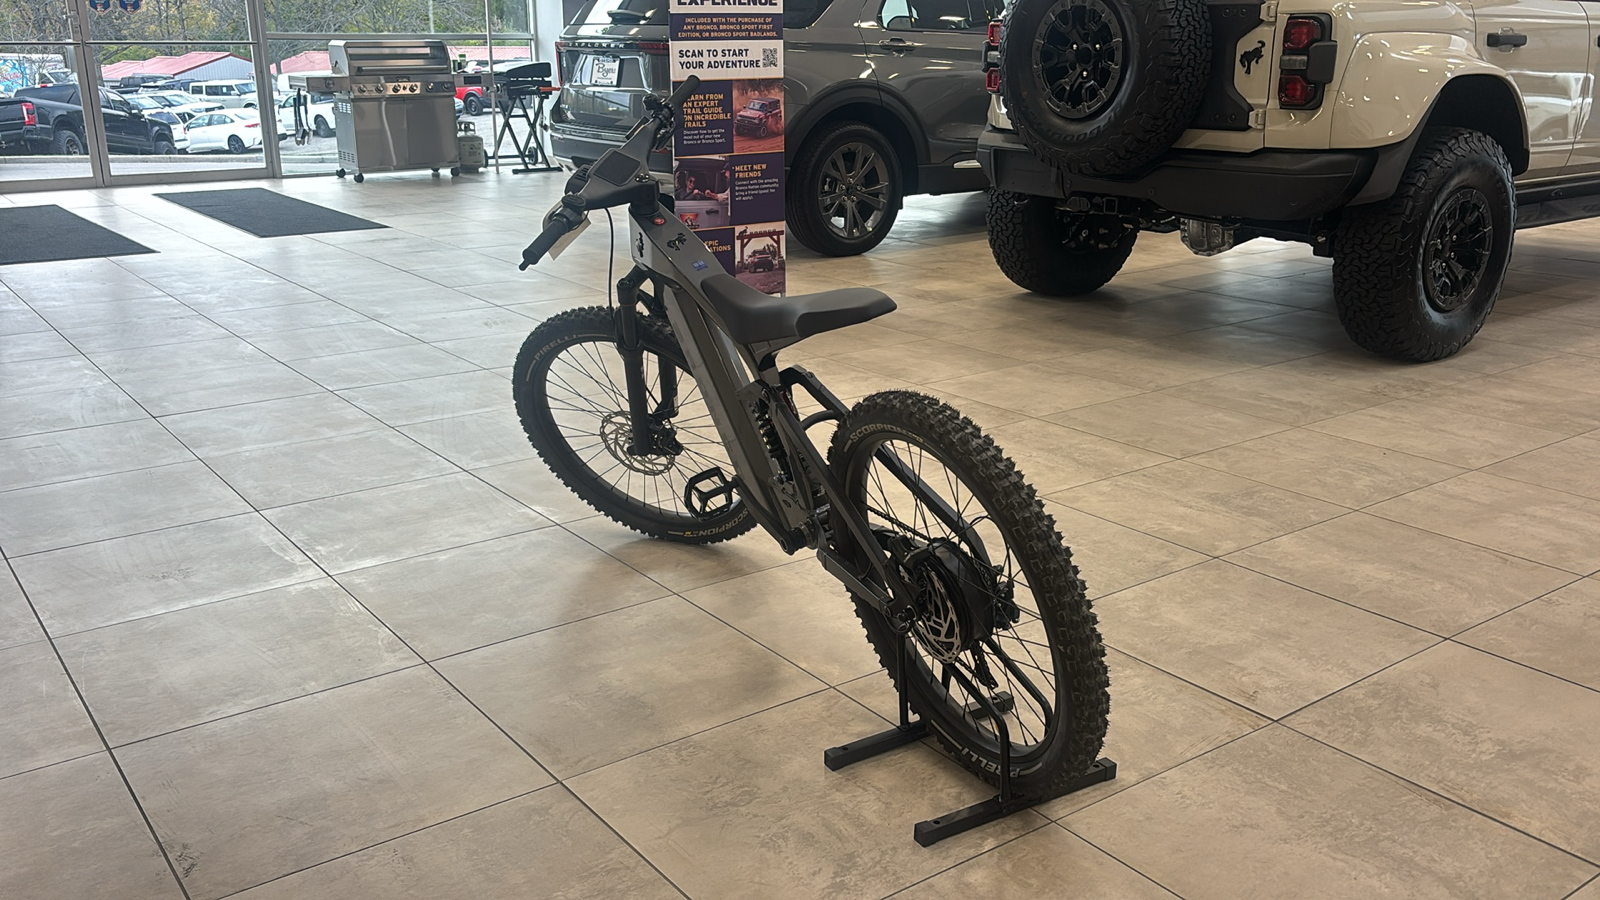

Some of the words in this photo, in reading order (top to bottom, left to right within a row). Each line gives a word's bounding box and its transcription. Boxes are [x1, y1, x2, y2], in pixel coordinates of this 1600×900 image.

[678, 50, 704, 58] SCAN
[707, 49, 718, 58] TO
[721, 48, 750, 57] START
[679, 61, 704, 70] YOUR
[707, 60, 760, 69] ADVENTURE
[694, 113, 731, 121] INCREDIBLE
[534, 334, 578, 361] PIRELLI
[850, 423, 908, 443] SCORPION
[699, 508, 748, 537] SCORPION
[961, 747, 1021, 778] PRELLI
